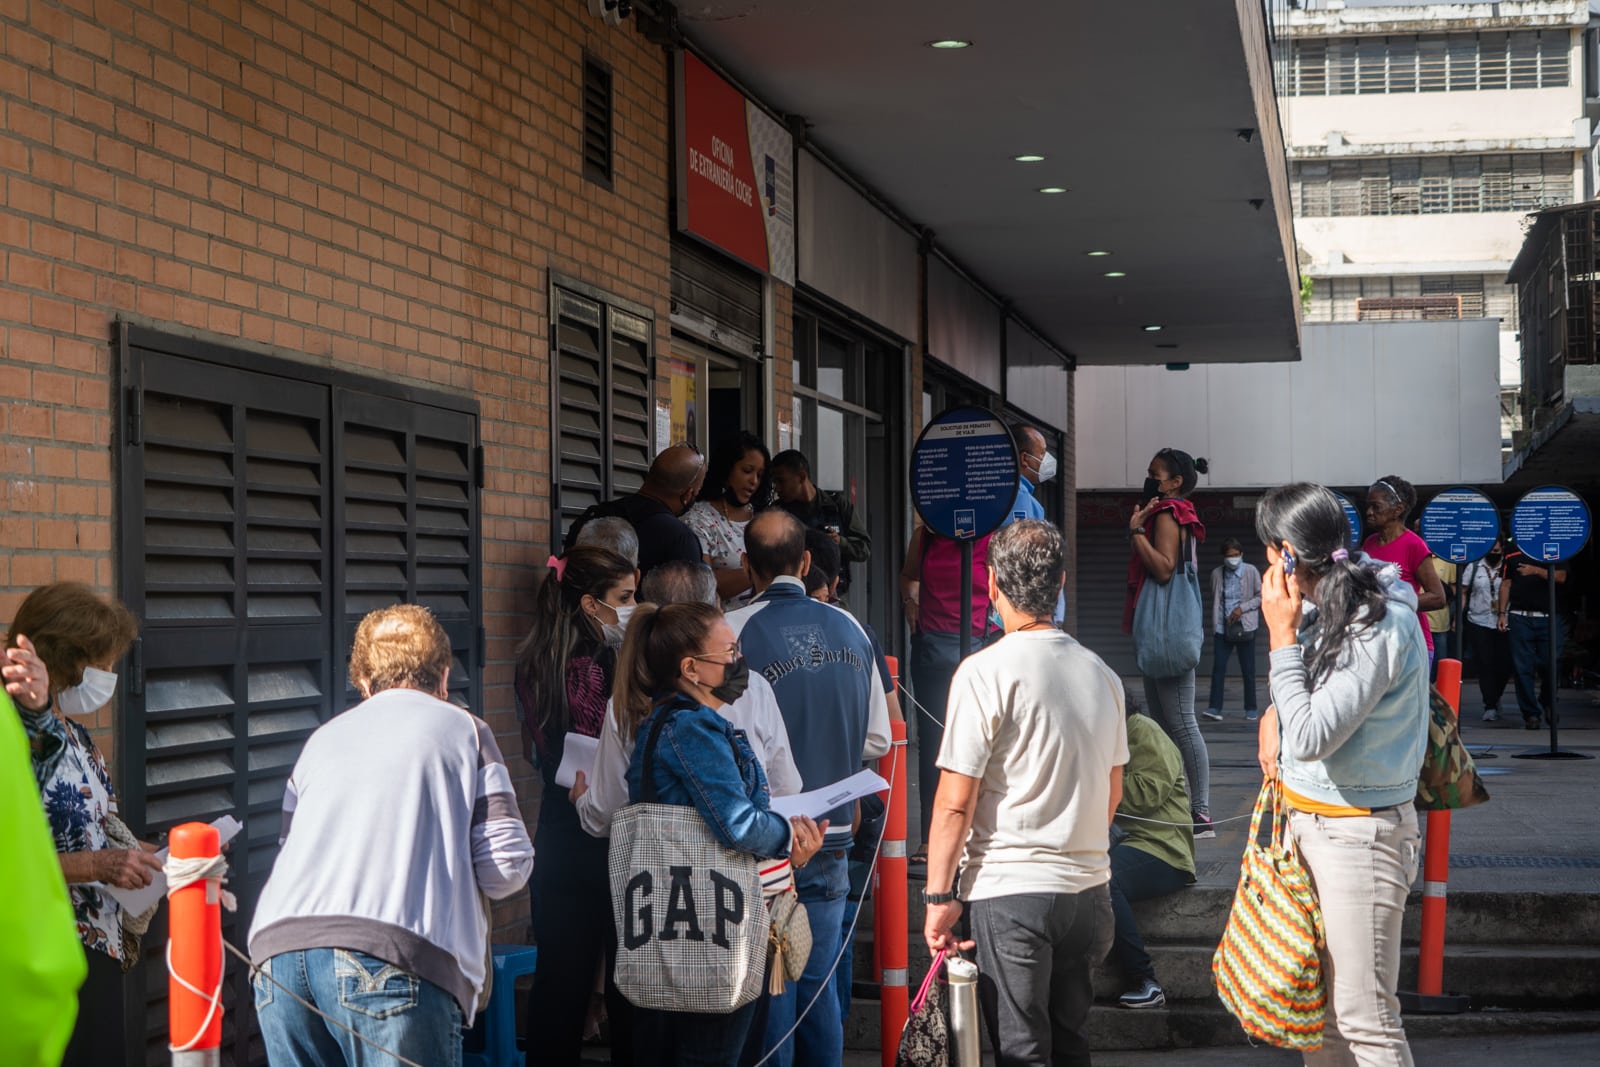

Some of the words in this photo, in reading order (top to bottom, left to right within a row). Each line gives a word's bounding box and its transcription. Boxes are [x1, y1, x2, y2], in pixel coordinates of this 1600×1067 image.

[689, 147, 698, 172] DE
[735, 178, 752, 207] COCHE
[712, 135, 734, 169] OFICINA
[623, 865, 745, 952] GAP
